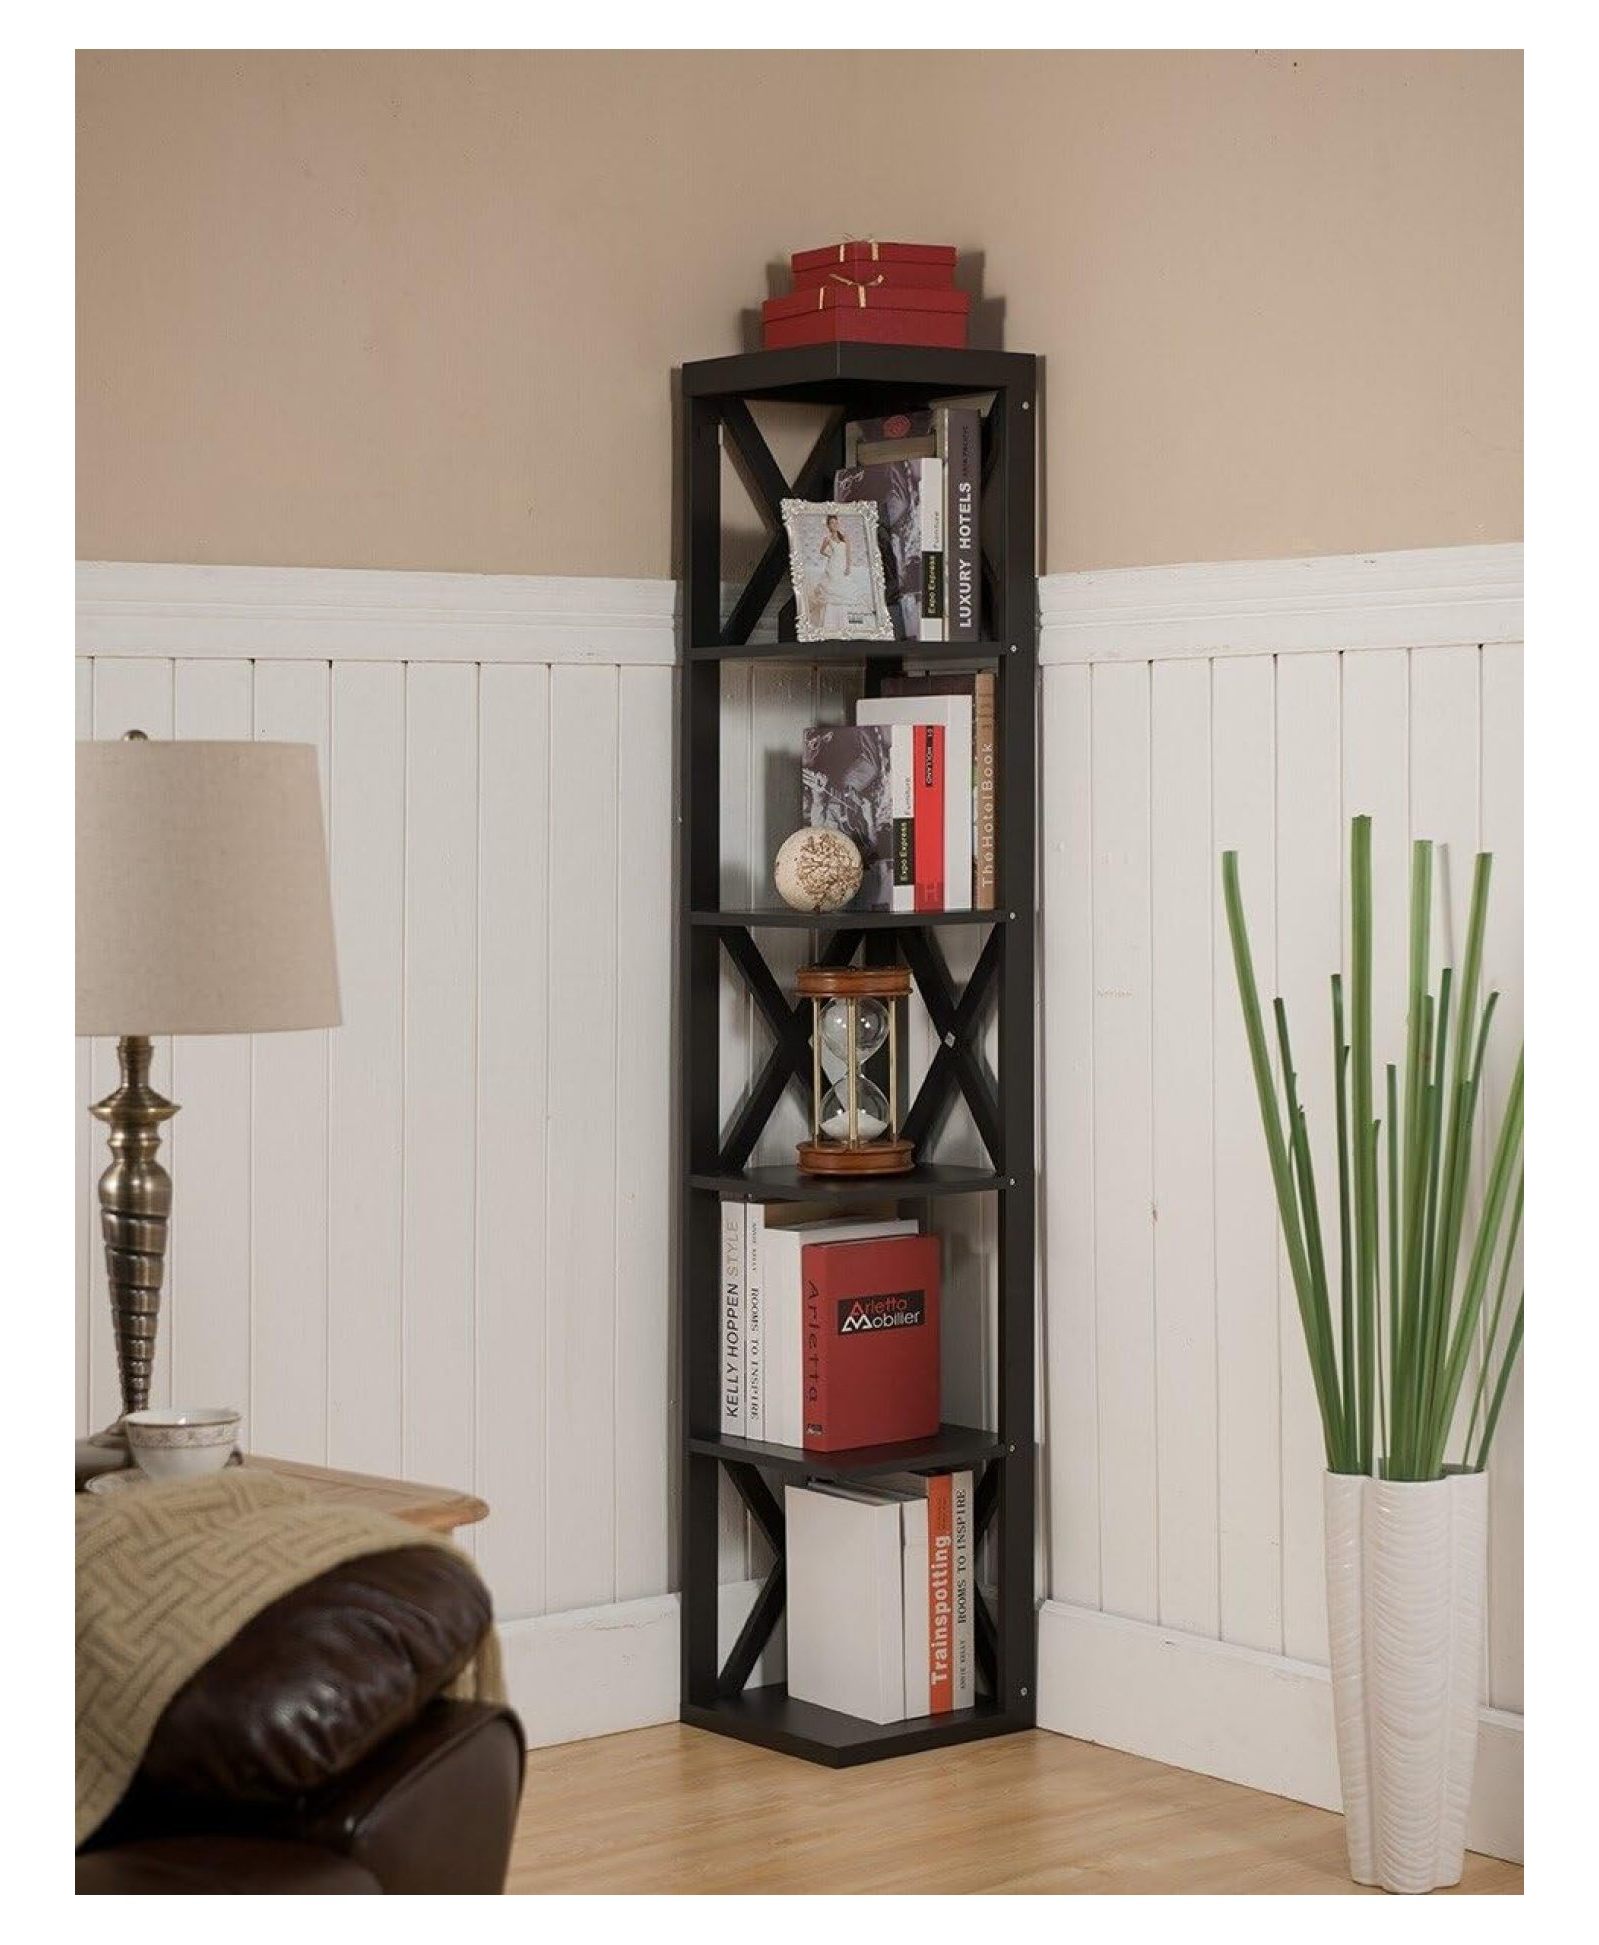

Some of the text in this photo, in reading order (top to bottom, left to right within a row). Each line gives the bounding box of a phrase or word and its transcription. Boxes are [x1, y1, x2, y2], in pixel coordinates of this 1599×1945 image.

[959, 481, 971, 549] HOTELS
[928, 555, 936, 614] Expo Express
[959, 559, 971, 628] LUXURY
[900, 822, 908, 882] Expo Express
[726, 1221, 738, 1418] KELLY HOPPEN STYLE
[750, 1287, 758, 1332] ROOMS
[750, 1339, 758, 1356] TO
[750, 1360, 758, 1420] INSPIRE
[957, 1489, 967, 1550] INSPIRE
[957, 1555, 967, 1572] TO
[931, 1535, 951, 1685] Trainspotting
[957, 1579, 967, 1624] ROOMS
